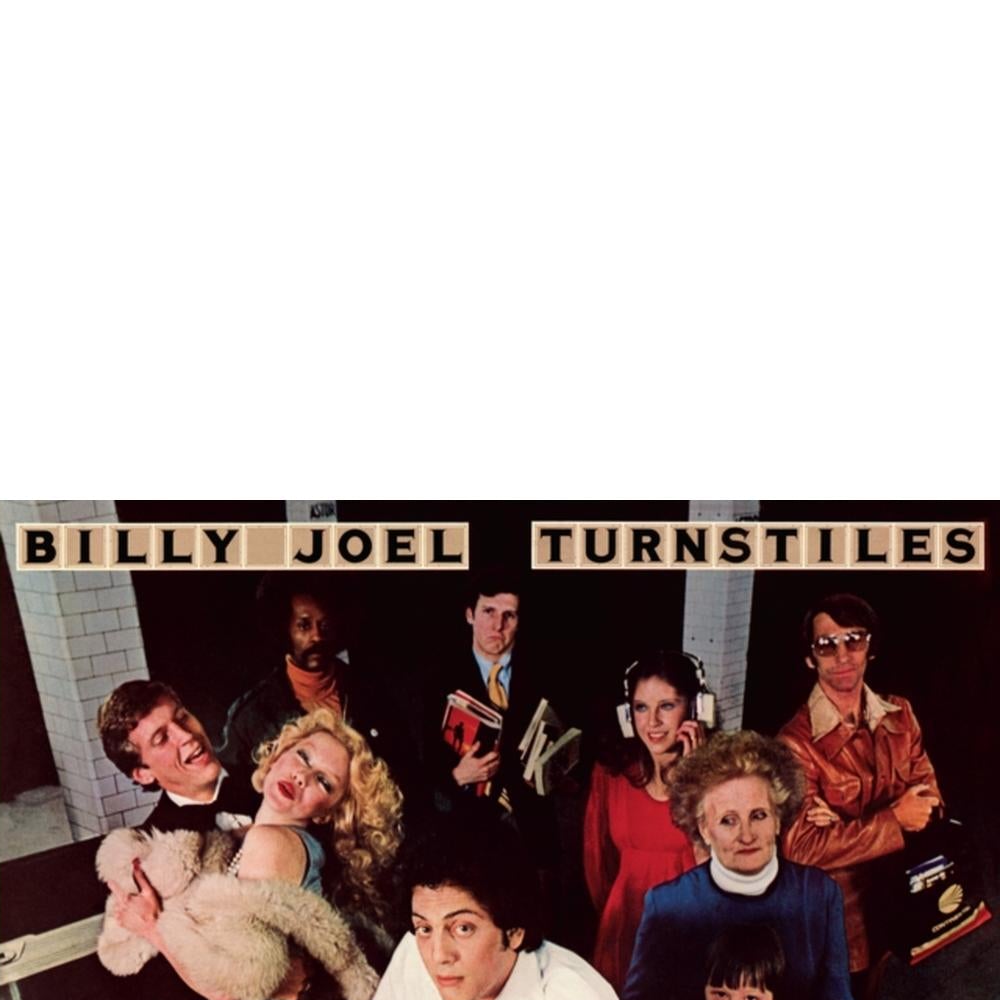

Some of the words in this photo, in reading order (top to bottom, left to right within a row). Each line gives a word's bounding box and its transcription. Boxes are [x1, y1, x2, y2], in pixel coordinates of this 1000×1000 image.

[25, 528, 239, 564] BILLY
[292, 528, 463, 564] JOEL
[539, 527, 976, 564] TURNSTILES
